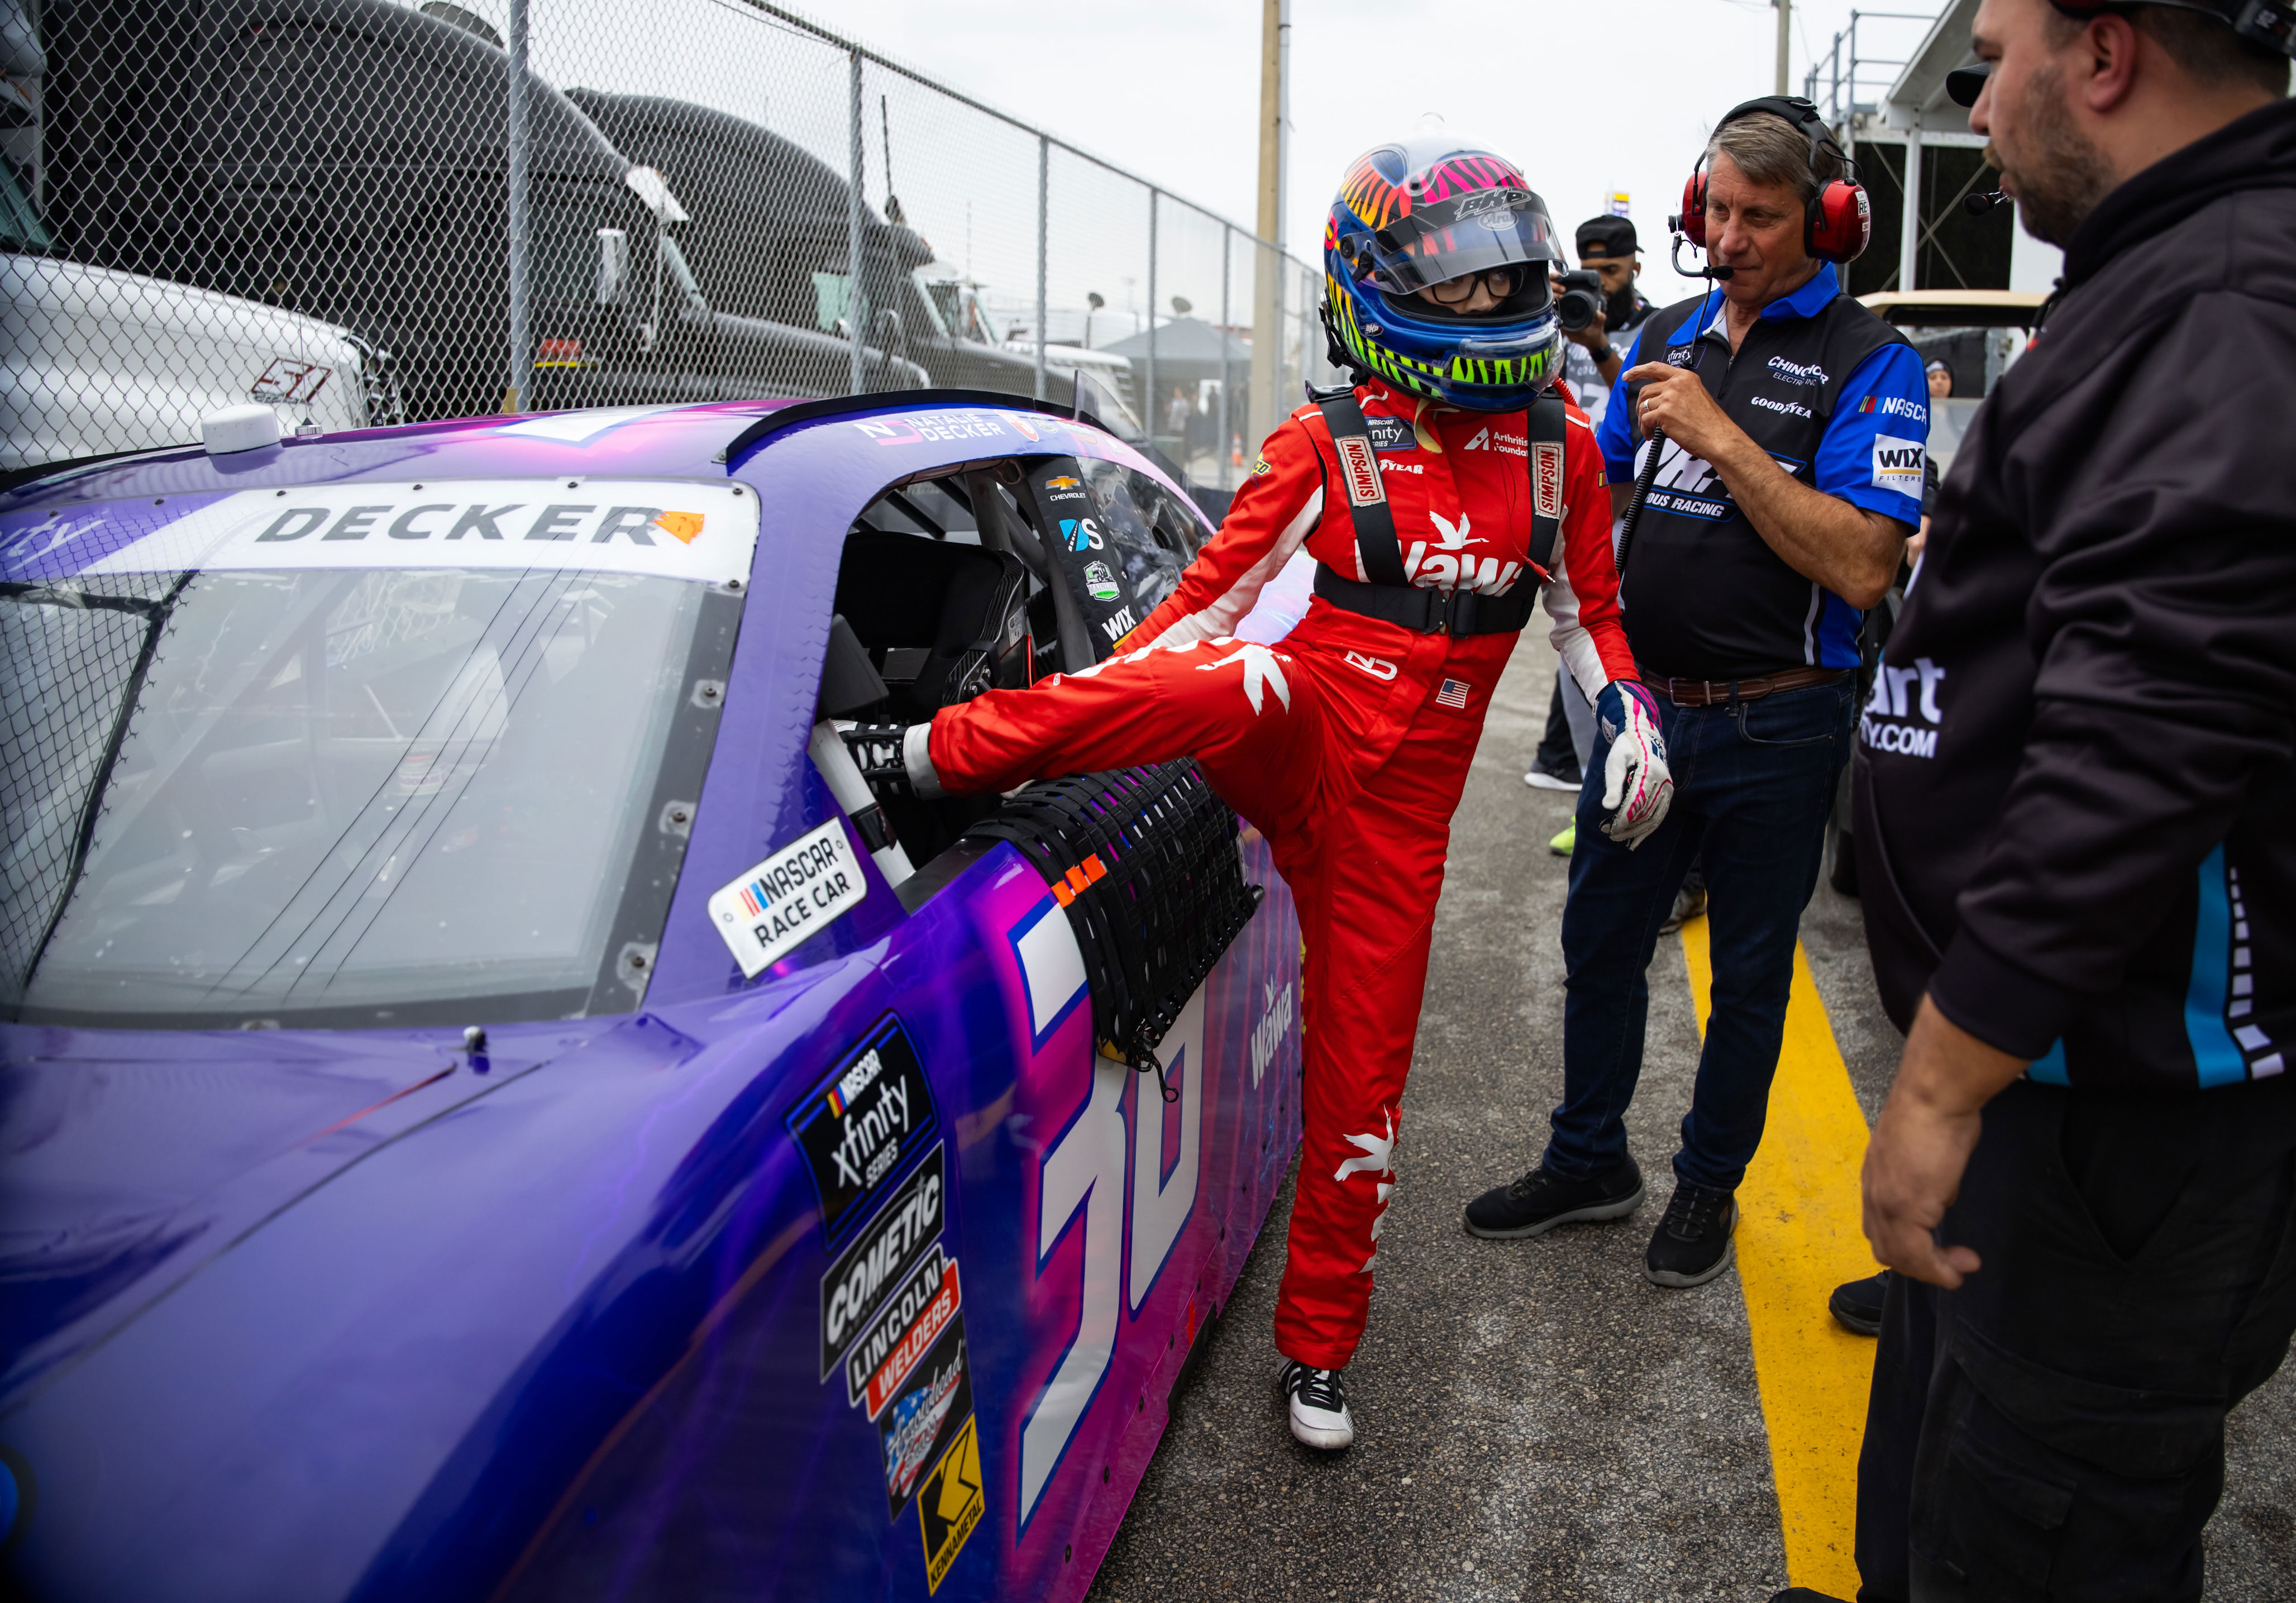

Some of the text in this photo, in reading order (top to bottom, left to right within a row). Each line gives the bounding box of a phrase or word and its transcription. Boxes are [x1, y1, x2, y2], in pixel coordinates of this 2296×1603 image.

[1667, 349, 1691, 364] xfinity
[904, 413, 982, 428] NATALIE
[919, 422, 1006, 441] DECKER
[1751, 397, 1812, 418] GOODYEA
[1882, 397, 1926, 424] NASCA
[1369, 426, 1403, 443] nity
[1493, 431, 1529, 447] Arthritis
[1878, 448, 1923, 469] WIX
[1346, 444, 1375, 497] SIMPSON
[1540, 450, 1555, 511] SIMPSON
[1050, 492, 1086, 502] CHEVROLET
[1671, 498, 1725, 517] RACING
[255, 504, 664, 546] DECKER
[1102, 604, 1137, 642] WIX
[760, 837, 838, 904] NASCAR
[755, 872, 851, 948] RACE CAR
[1251, 981, 1292, 1091] Wawa
[840, 1048, 884, 1105] NASCAR
[832, 1074, 909, 1189] xfinity
[866, 1137, 899, 1189] SERIES
[827, 1174, 940, 1344] COMETIC
[852, 1259, 940, 1383] LINCOLN
[879, 1288, 951, 1399] WELDERS
[886, 1339, 964, 1476] Arrowhead
[930, 1496, 983, 1587] KENNAMETAL
